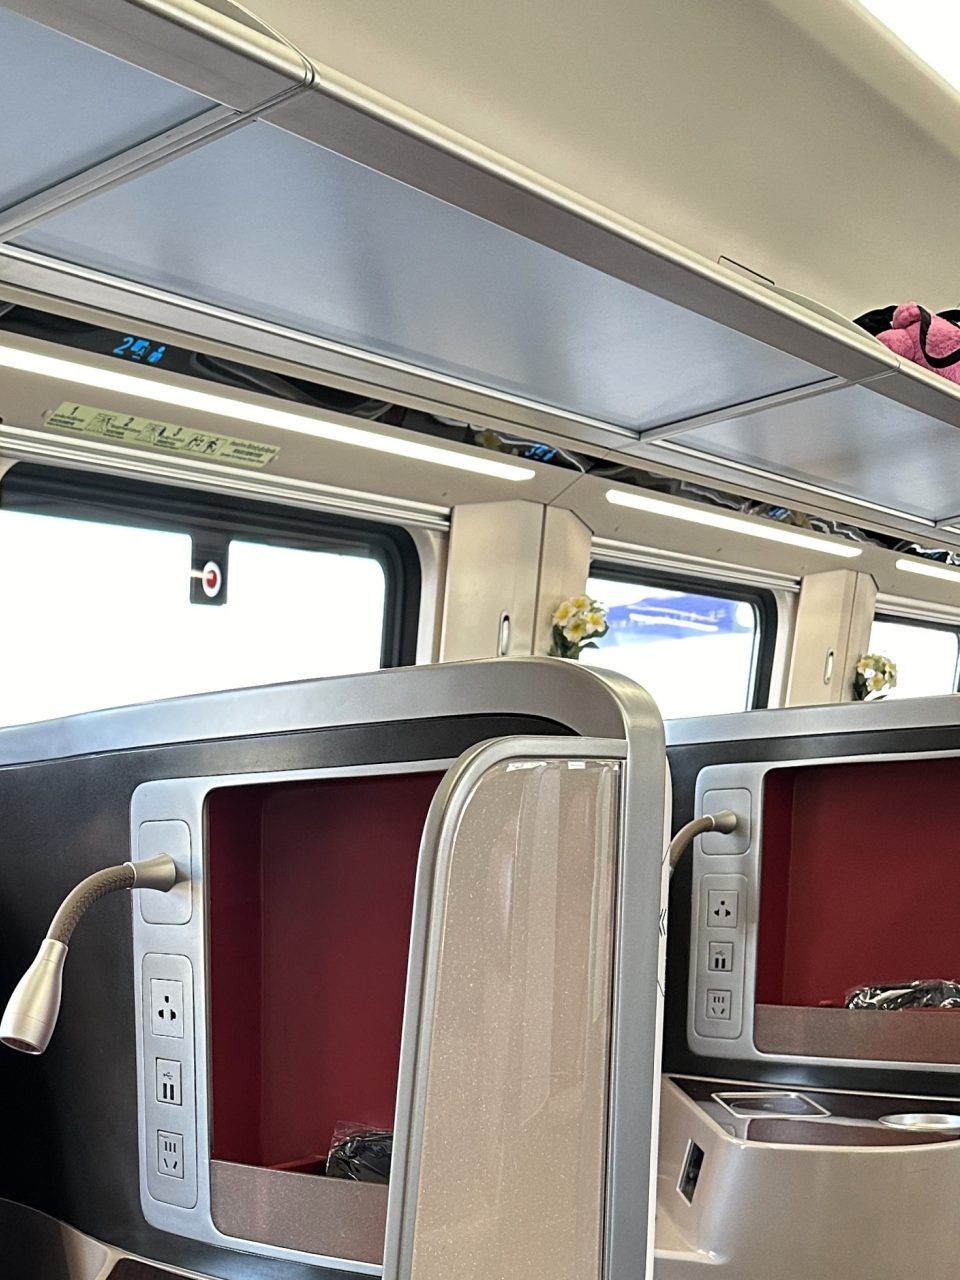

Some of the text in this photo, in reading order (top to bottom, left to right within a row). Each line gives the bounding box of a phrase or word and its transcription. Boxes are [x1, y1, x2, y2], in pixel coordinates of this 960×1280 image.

[113, 337, 134, 355] 2
[70, 406, 80, 416] 1
[124, 417, 135, 427] 2
